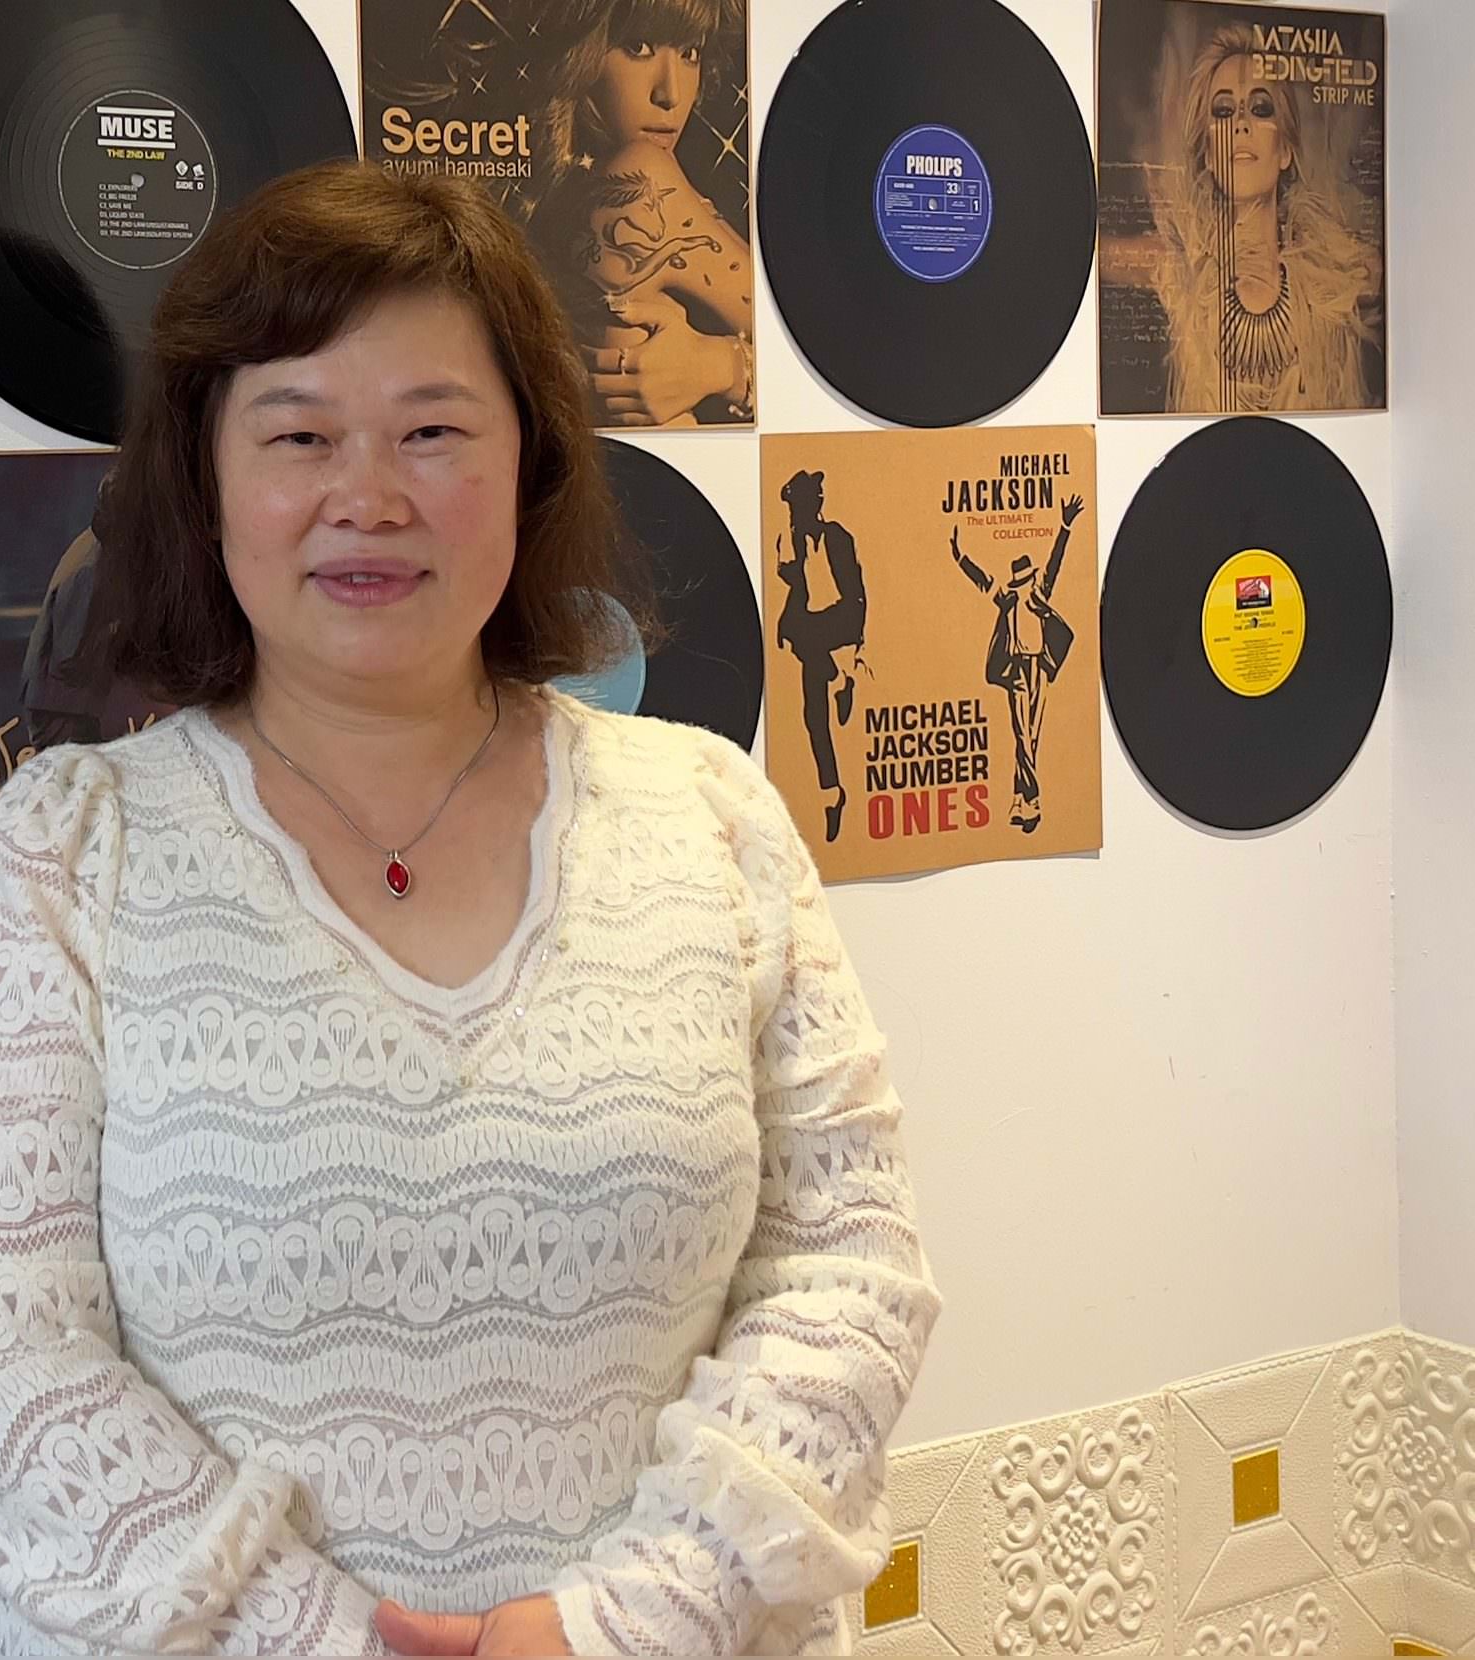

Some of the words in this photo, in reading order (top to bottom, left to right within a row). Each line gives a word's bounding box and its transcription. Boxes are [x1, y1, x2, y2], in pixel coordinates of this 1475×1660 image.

[1312, 85, 1349, 105] STRIP
[1353, 88, 1375, 106] ME
[100, 115, 173, 140] MUSE
[381, 106, 531, 157] Secret
[107, 148, 125, 159] THE
[126, 149, 144, 160] 2ND
[145, 150, 165, 160] LAW
[906, 154, 963, 178] PHOLIPS
[444, 156, 532, 178] hamasaki
[972, 199, 980, 212] 1
[1000, 453, 1070, 477] MICHAEL
[941, 477, 1053, 513] JACKSON
[966, 515, 984, 526] The
[985, 513, 1034, 526] ULTIMATE
[992, 527, 1054, 540] COLLECTION
[865, 698, 988, 734] MICHAEL
[865, 726, 988, 762] JACKSON
[866, 754, 989, 792] NUMBER
[867, 783, 990, 840] ONES
